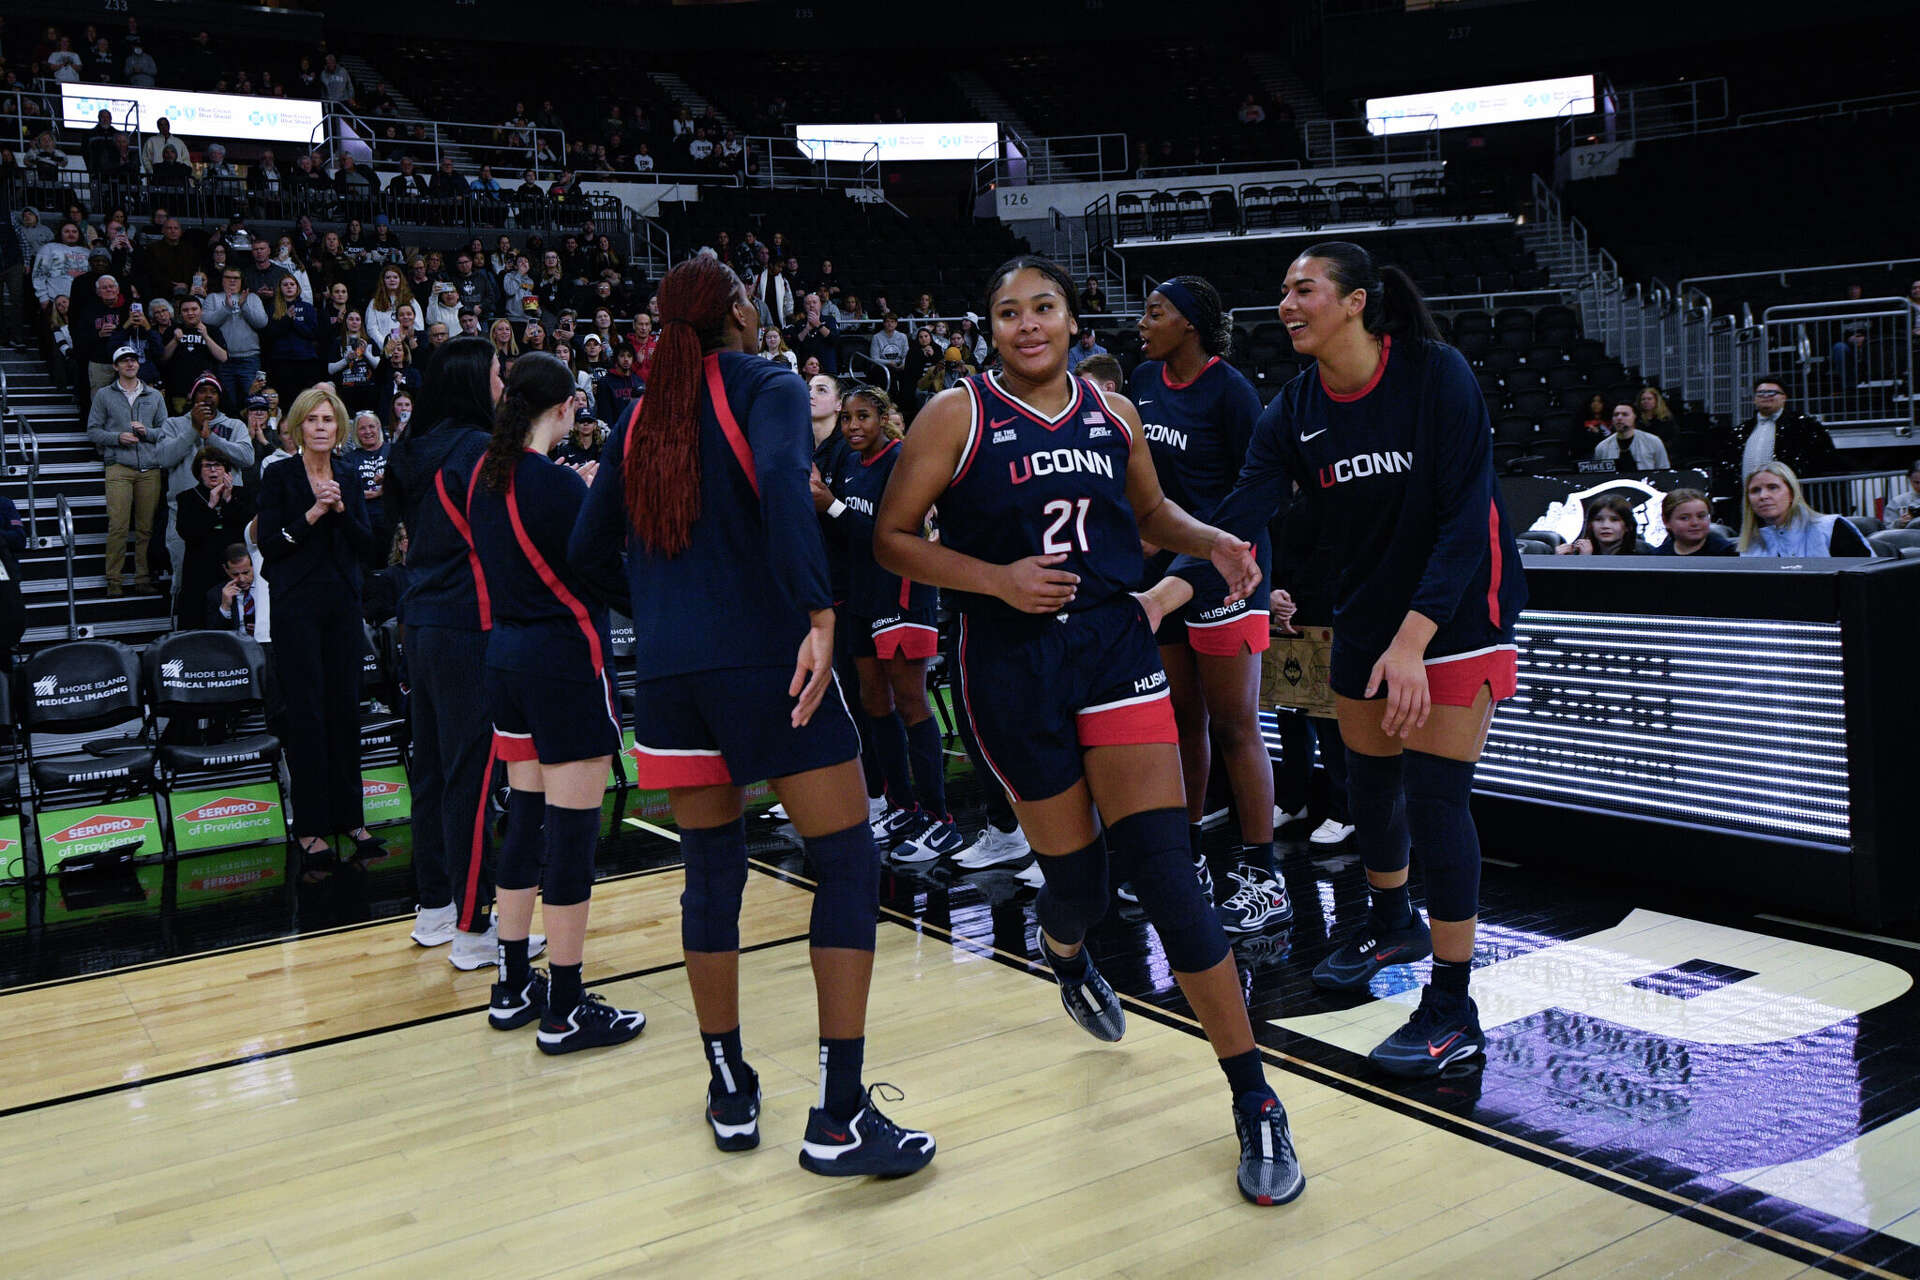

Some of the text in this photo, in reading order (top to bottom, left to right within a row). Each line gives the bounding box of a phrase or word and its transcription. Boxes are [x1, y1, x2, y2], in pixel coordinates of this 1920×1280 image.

[1003, 193, 1028, 206] 126
[1143, 424, 1188, 451] CONN
[1009, 449, 1113, 485] UCONN
[1319, 451, 1414, 488] UCONN
[845, 496, 874, 516] CONN
[1042, 498, 1091, 555] 21
[1200, 599, 1247, 620] HUSKIES
[184, 667, 249, 679] RHODE ISLAND
[1134, 669, 1167, 693] HUSK
[59, 675, 127, 694] RHODE ISLAND
[163, 677, 249, 689] MEDICAL IMAGING
[36, 685, 129, 707] MEDICAL IMAGING
[203, 751, 261, 766] FRIARTOWN
[68, 767, 130, 784] FRIARTOWN
[198, 802, 256, 818] SERVPRO
[68, 819, 131, 838] SERVPRO
[188, 817, 271, 836] of Providence
[58, 834, 147, 857] of Providence
